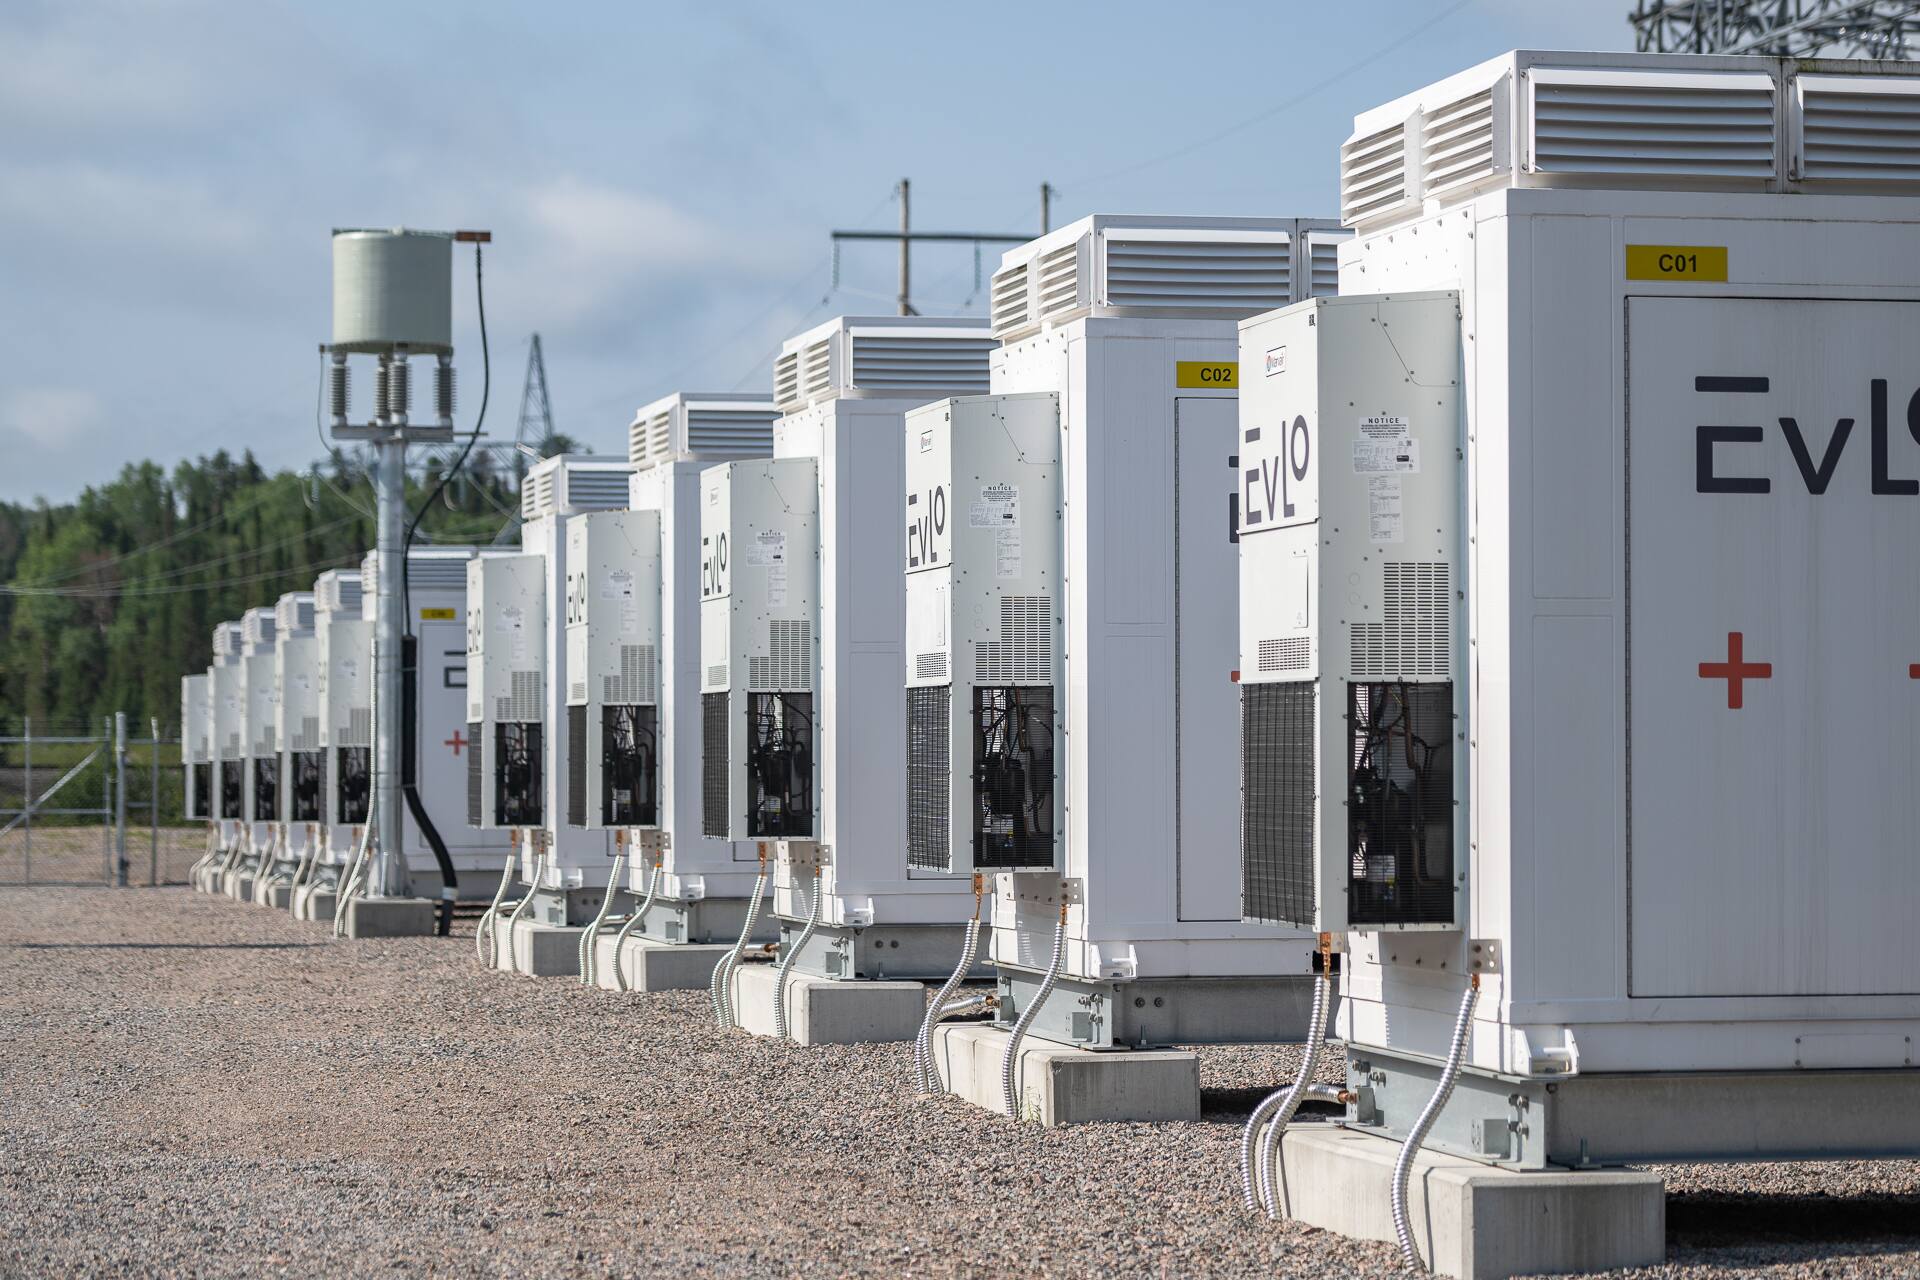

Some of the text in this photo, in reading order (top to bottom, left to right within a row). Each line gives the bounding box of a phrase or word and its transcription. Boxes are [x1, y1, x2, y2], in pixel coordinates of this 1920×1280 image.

[1659, 254, 1697, 272] C01
[1200, 368, 1232, 382] C02
[1695, 376, 1920, 495] EVL
[1245, 415, 1310, 525] EVLO
